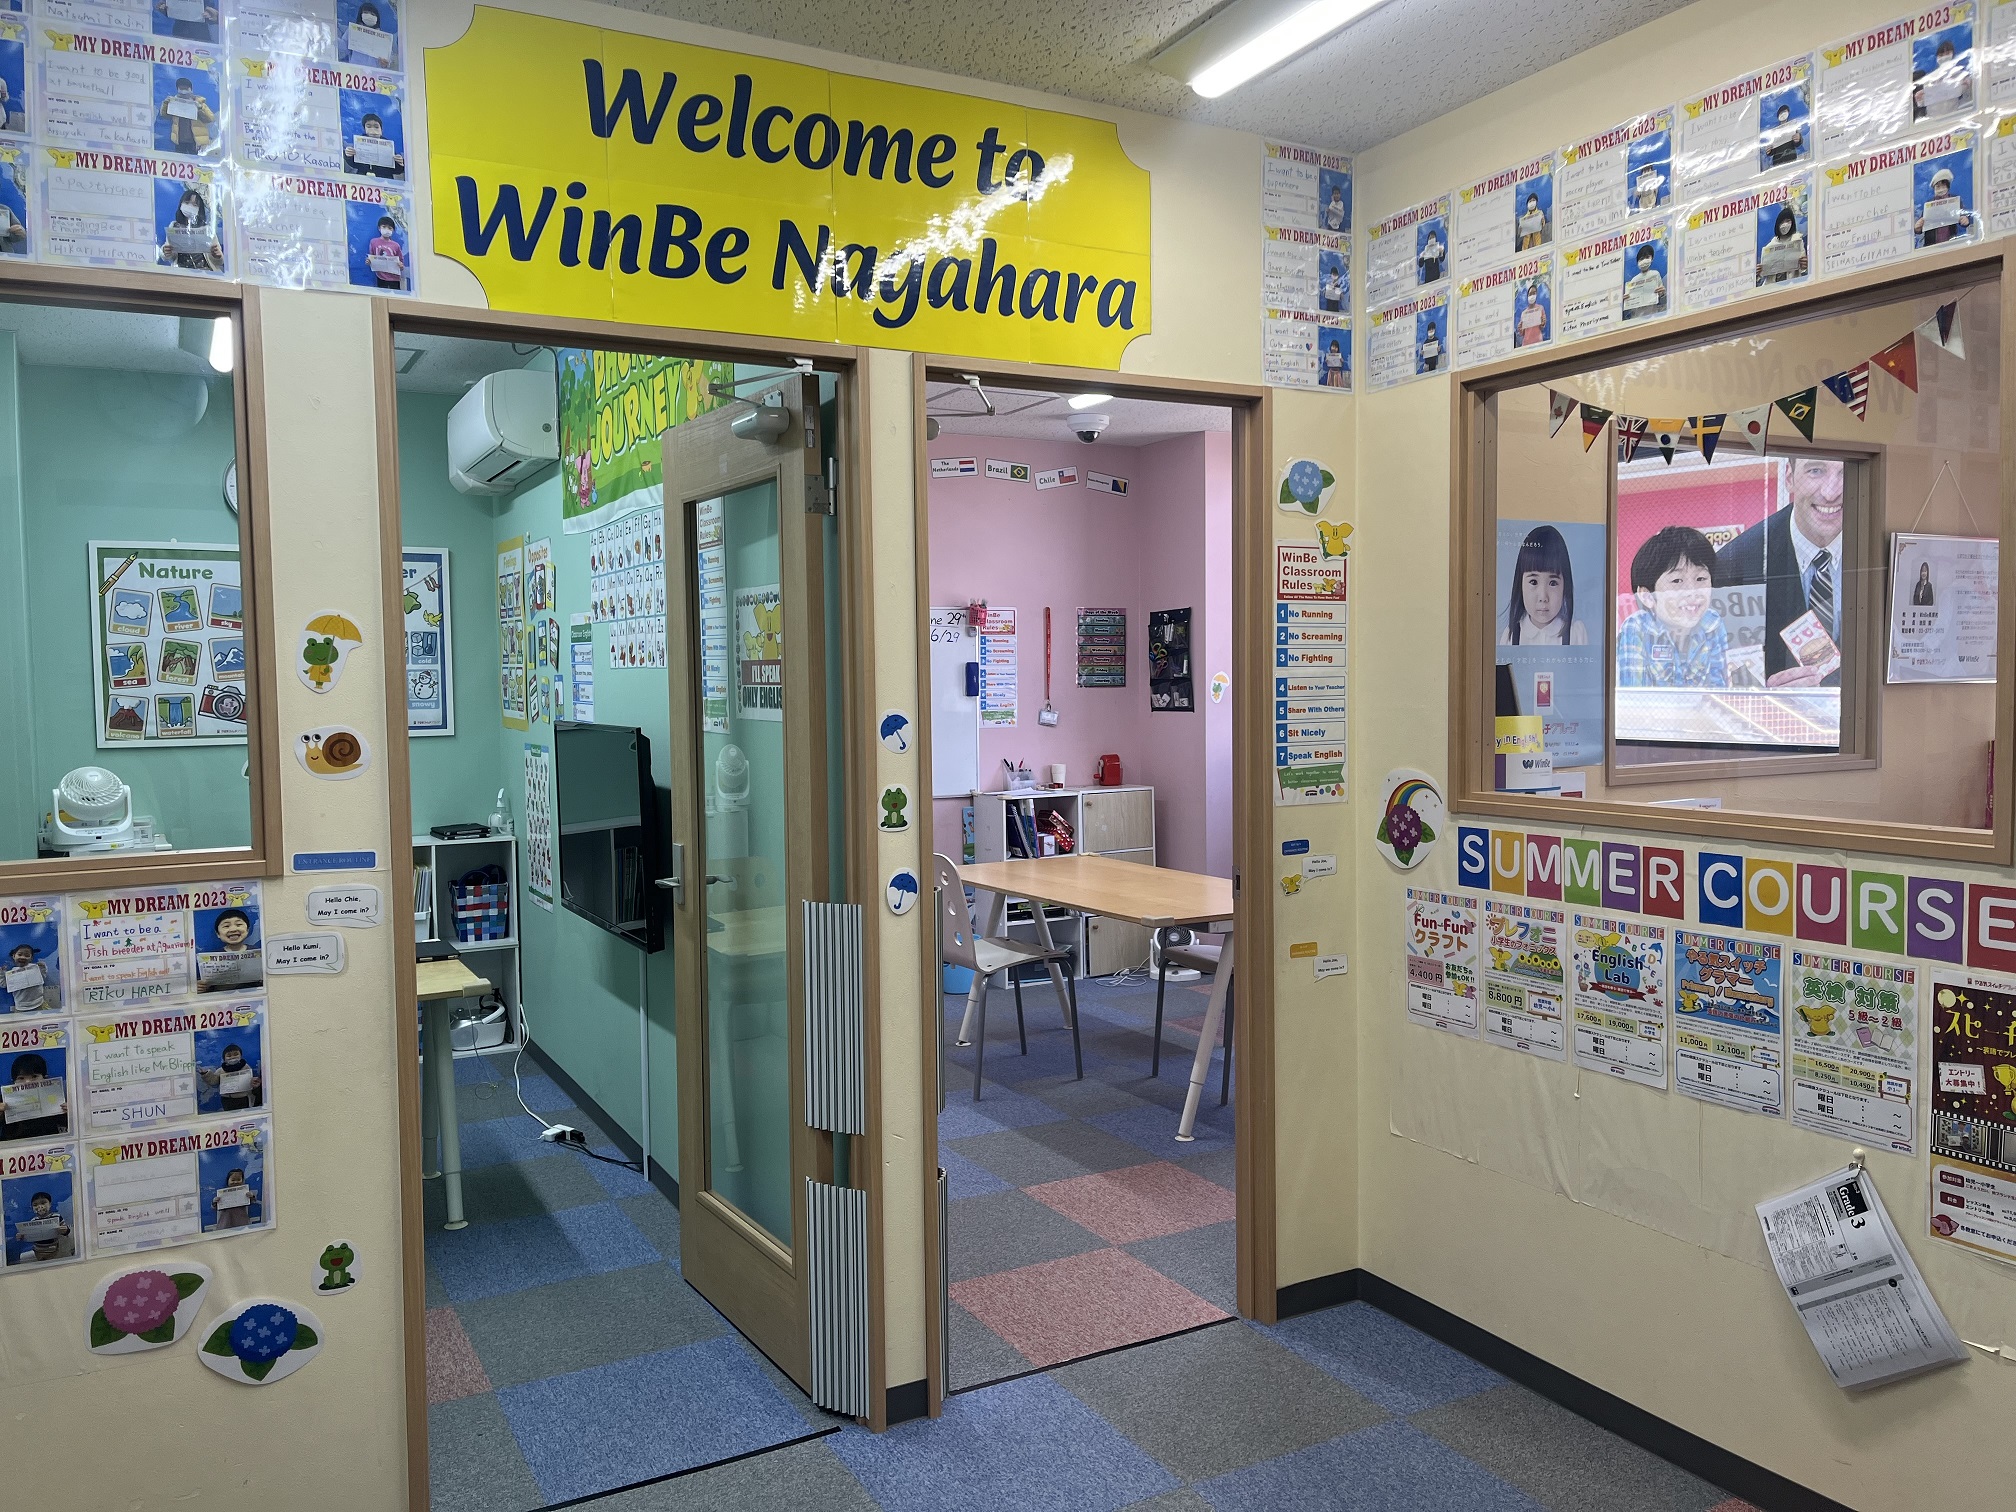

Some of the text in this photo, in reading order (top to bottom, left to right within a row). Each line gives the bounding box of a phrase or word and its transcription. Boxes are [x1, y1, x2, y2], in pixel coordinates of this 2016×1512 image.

[1845, 7, 1950, 60] MY DREAM 2023
[74, 34, 192, 66] MY DREAM 2023
[57, 61, 84, 73] want
[67, 78, 115, 96] basketball
[346, 73, 376, 92] 2023
[1703, 66, 1792, 112] MY DREAM 2023
[582, 58, 1046, 200] Welcome to
[1279, 145, 1340, 170] MY DREAM 2023
[1578, 141, 1593, 159] MY
[1848, 134, 1952, 179] MY DREAM 2023
[76, 151, 194, 179] MY DREAM 2023
[1473, 161, 1540, 198] MY DREAM 2023
[296, 180, 382, 203] DREAM 2023
[1703, 185, 1788, 224] MY DREAM 2023
[1380, 202, 1438, 235] MY DREAM 2023
[1279, 228, 1291, 240] MY
[1293, 229, 1321, 246] DREAM
[1578, 227, 1651, 262] MY DREAM 2023
[455, 175, 1135, 330] WinBe Nagahara
[1472, 260, 1539, 293] MY DREAM 2023
[1382, 295, 1436, 323] MY DREAM 2023
[590, 361, 682, 469] JOURNEY
[987, 465, 1008, 475] Brazil
[1039, 477, 1056, 485] Chile
[1282, 552, 1318, 563] WinBe
[138, 562, 214, 580] Nature
[1282, 566, 1342, 578] Classroom
[1282, 579, 1313, 590] Rules
[1288, 610, 1299, 618] No
[1301, 610, 1333, 620] Running
[117, 620, 233, 635] cloud river sky
[930, 628, 960, 643] 6/29
[1288, 632, 1299, 640] No
[1301, 632, 1343, 642] Screaming
[417, 657, 432, 665] cold
[1288, 654, 1299, 662] No
[1301, 654, 1333, 663] Fighting
[165, 674, 190, 683] forest
[761, 664, 781, 684] SPEAK
[411, 701, 436, 709] snowy
[760, 686, 783, 709] ENGLIS
[161, 729, 192, 737] waterfall
[1288, 729, 1299, 737] Sit
[1301, 728, 1326, 738] Nicely
[1288, 751, 1313, 762] Speak
[1314, 750, 1343, 760] English
[107, 890, 227, 916] MY DREAM 2023
[1407, 889, 1477, 909] SUMMER COURSE
[1461, 833, 2016, 953] SUMMER COURSE
[317, 909, 332, 917] May
[359, 906, 370, 914] in?
[1486, 900, 1564, 923] SUMMER COURSE
[83, 924, 91, 940] I
[94, 925, 119, 939] want
[123, 927, 135, 936] to
[138, 924, 151, 934] be
[1574, 914, 1665, 940] SUMMER COURSE
[1415, 928, 1468, 952] クラフト
[1676, 932, 1781, 960] SUMMER COURSE
[112, 944, 144, 957] breeder
[1592, 949, 1644, 971] English
[275, 957, 290, 965] May
[1686, 948, 1767, 975] やる気スイッチ
[1793, 952, 1915, 984] SUMMER COURSE
[1605, 968, 1631, 985] Lab
[1700, 966, 1753, 987] グラマー
[88, 983, 171, 1002] RIKU HARAI
[115, 1010, 234, 1039] MY DREAM 2023
[1, 1029, 40, 1049] 2023
[93, 1041, 175, 1062] I want to speak
[92, 1067, 129, 1082] English
[131, 1063, 150, 1076] like
[121, 1103, 167, 1121] SHUN
[121, 1129, 238, 1160] MY DREAM 2023
[9, 1154, 46, 1174] 2023
[1839, 1186, 1866, 1229] Grade 3
